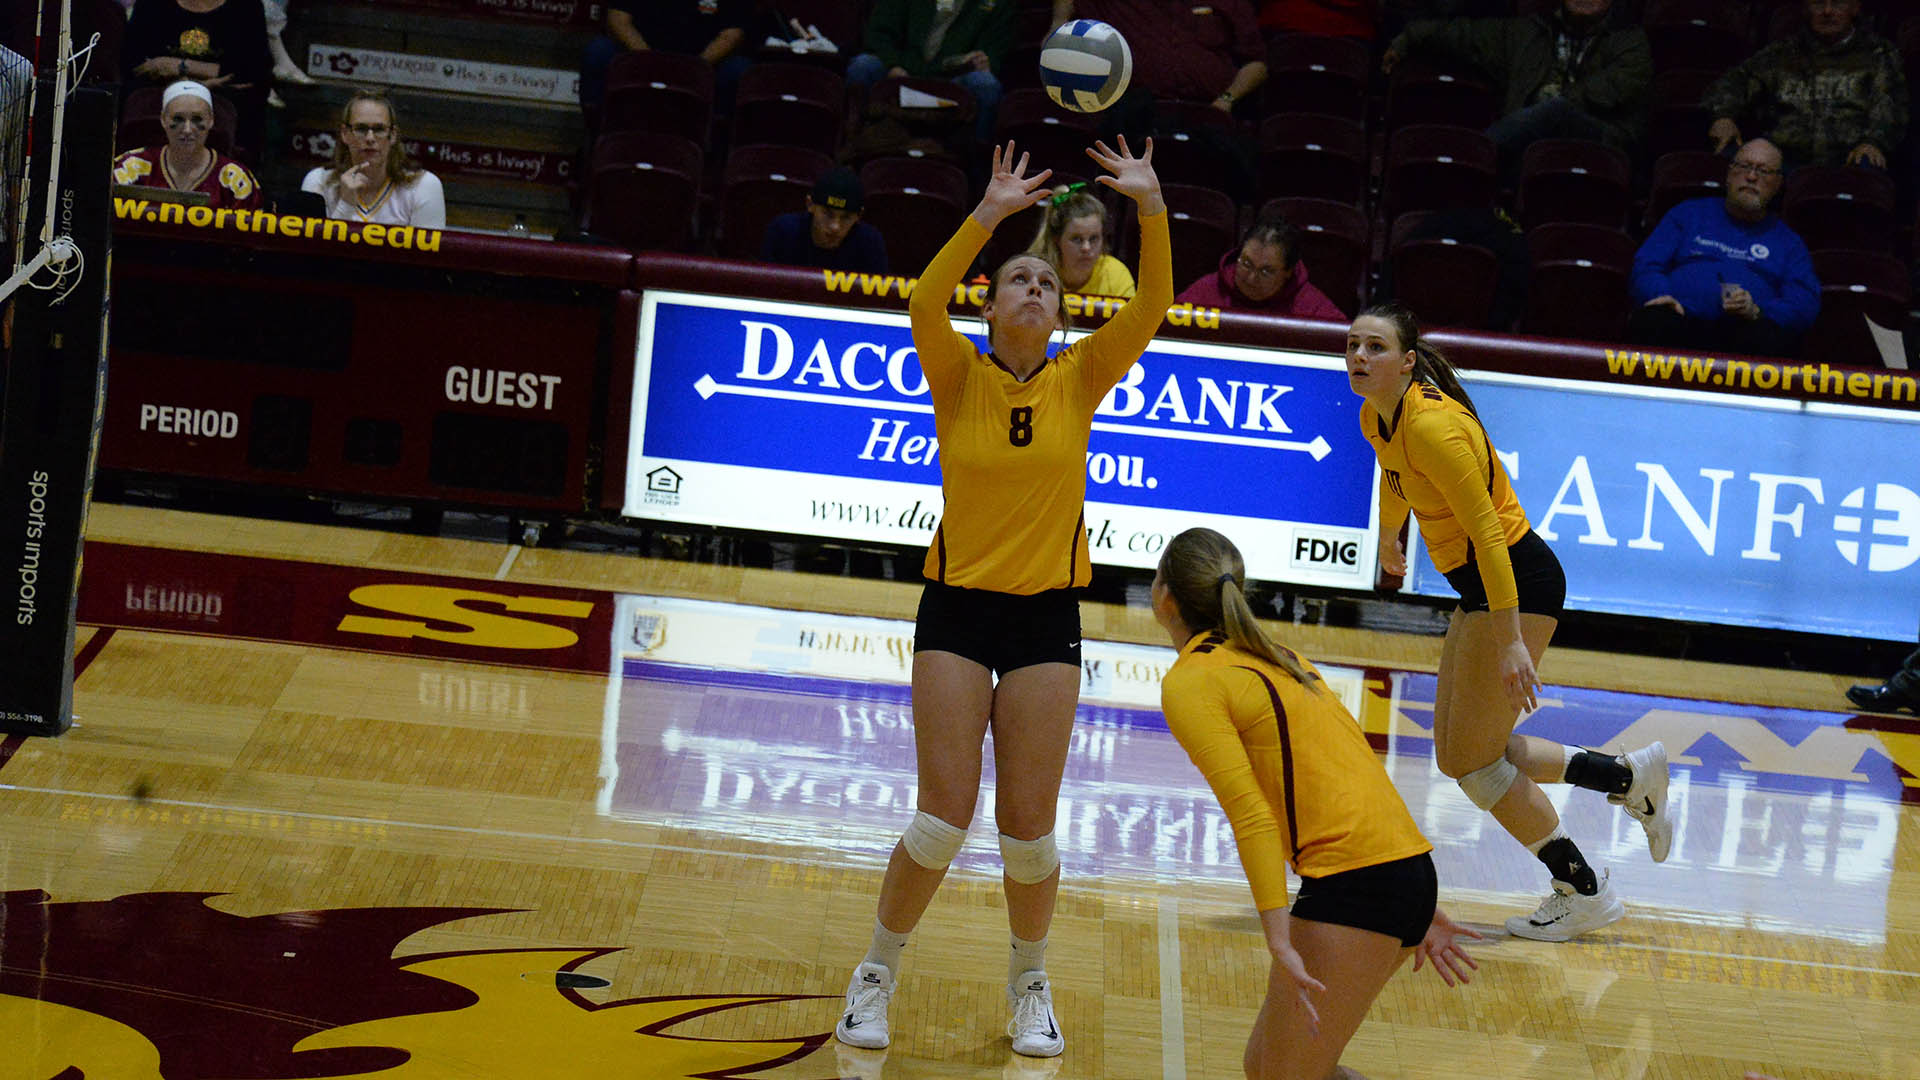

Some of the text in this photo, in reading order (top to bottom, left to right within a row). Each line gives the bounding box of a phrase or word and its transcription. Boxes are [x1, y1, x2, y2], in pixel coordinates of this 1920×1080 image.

[477, 152, 494, 168] is
[444, 365, 562, 411] GUEST
[1094, 361, 1294, 433] BANK
[140, 403, 239, 439] PERIOD
[1009, 405, 1033, 447] 8
[1497, 449, 1825, 562] ANF
[17, 470, 49, 625] sports imports
[1295, 537, 1358, 566] FDIC
